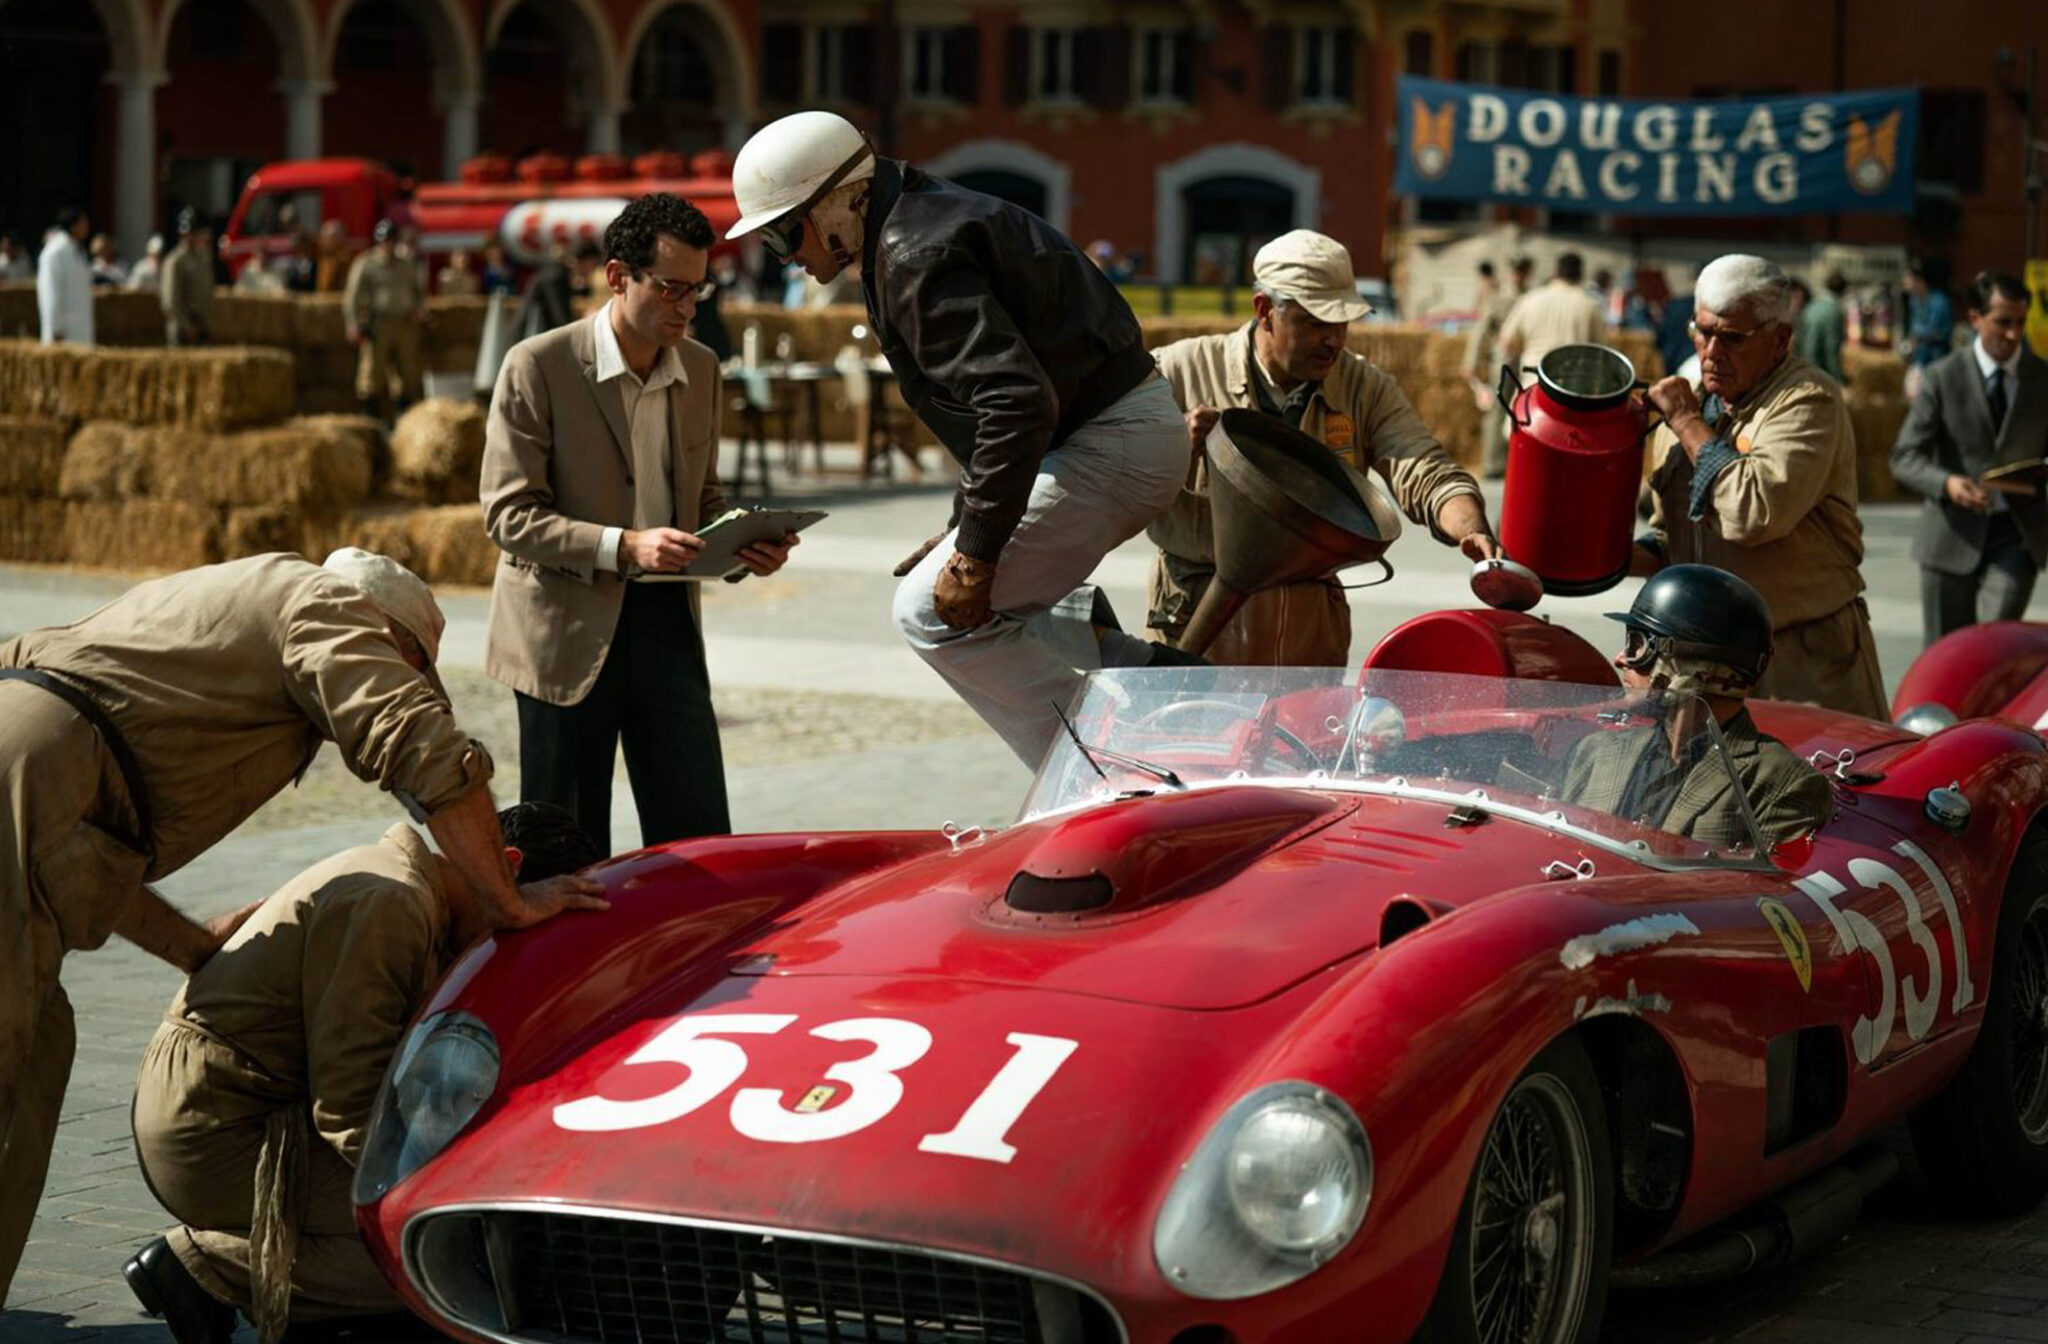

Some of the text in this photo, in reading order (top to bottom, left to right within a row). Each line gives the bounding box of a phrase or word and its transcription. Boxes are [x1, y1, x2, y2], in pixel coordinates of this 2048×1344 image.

[1467, 95, 1837, 153] DOUGLAS
[1492, 146, 1800, 204] RACING
[1790, 840, 1974, 1065] 531
[552, 1013, 1079, 1164] 531
